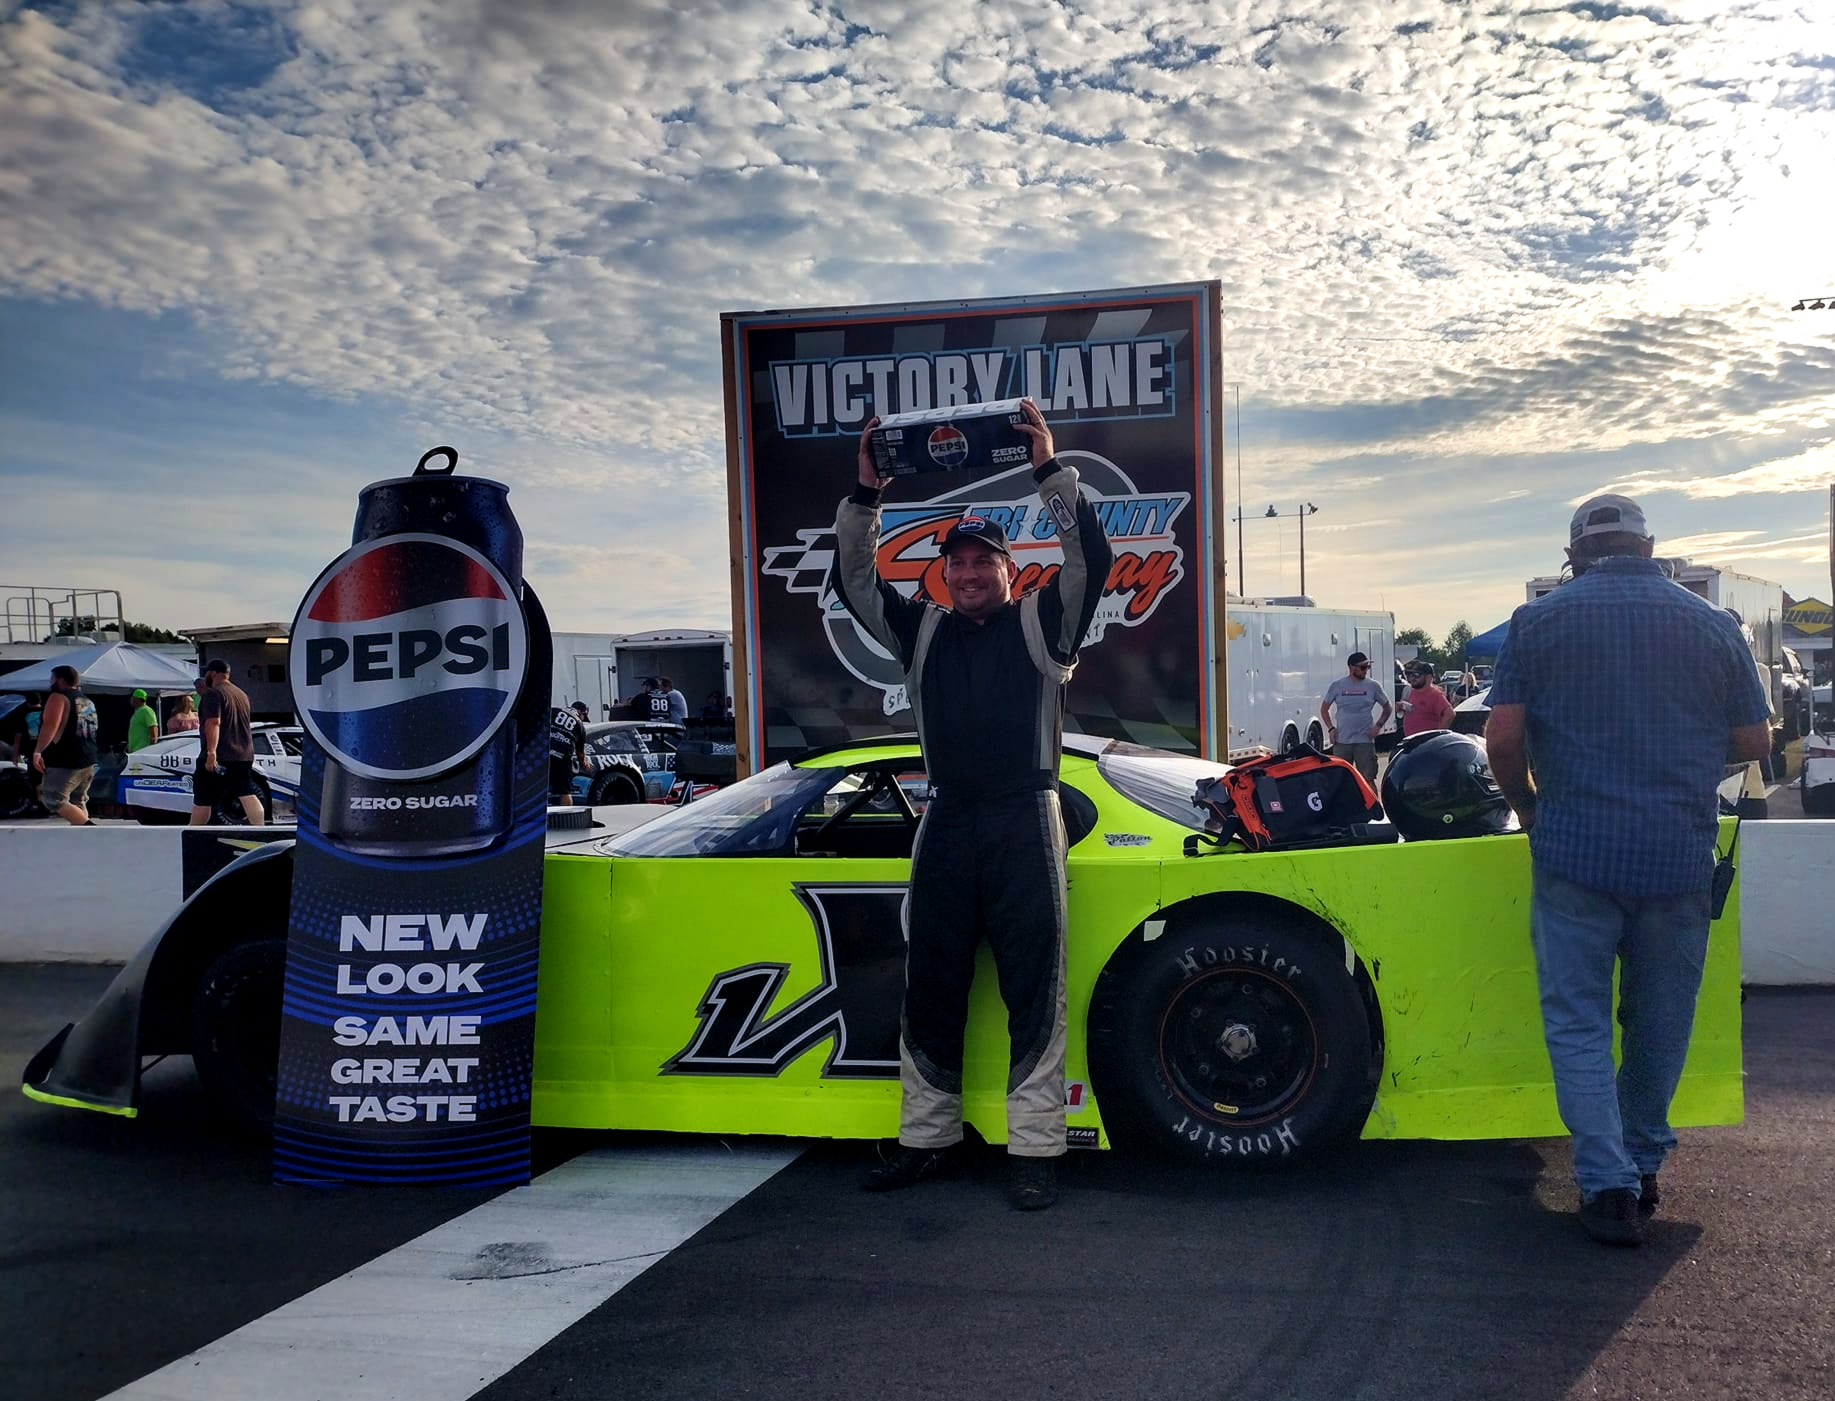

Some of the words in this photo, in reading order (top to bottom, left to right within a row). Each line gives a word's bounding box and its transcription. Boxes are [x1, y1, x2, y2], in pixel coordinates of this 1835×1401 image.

[774, 352, 1004, 426] VICTORY
[1026, 341, 1164, 412] LANE
[930, 440, 967, 453] PEPSI
[991, 445, 1027, 457] ZERO
[992, 453, 1028, 464] SUGAR
[305, 621, 510, 687] PEPSI
[650, 698, 668, 711] 88
[554, 711, 577, 731] 88
[350, 796, 402, 811] ZERO
[405, 794, 478, 809] SUGAR
[339, 913, 489, 952] NEW
[1176, 943, 1302, 980] Hoosier
[336, 962, 486, 995] LOOK
[332, 1015, 482, 1047] SAME
[330, 1058, 480, 1084] GREAT
[328, 1095, 477, 1122] TASTE
[1172, 1115, 1300, 1157] Hoosier
